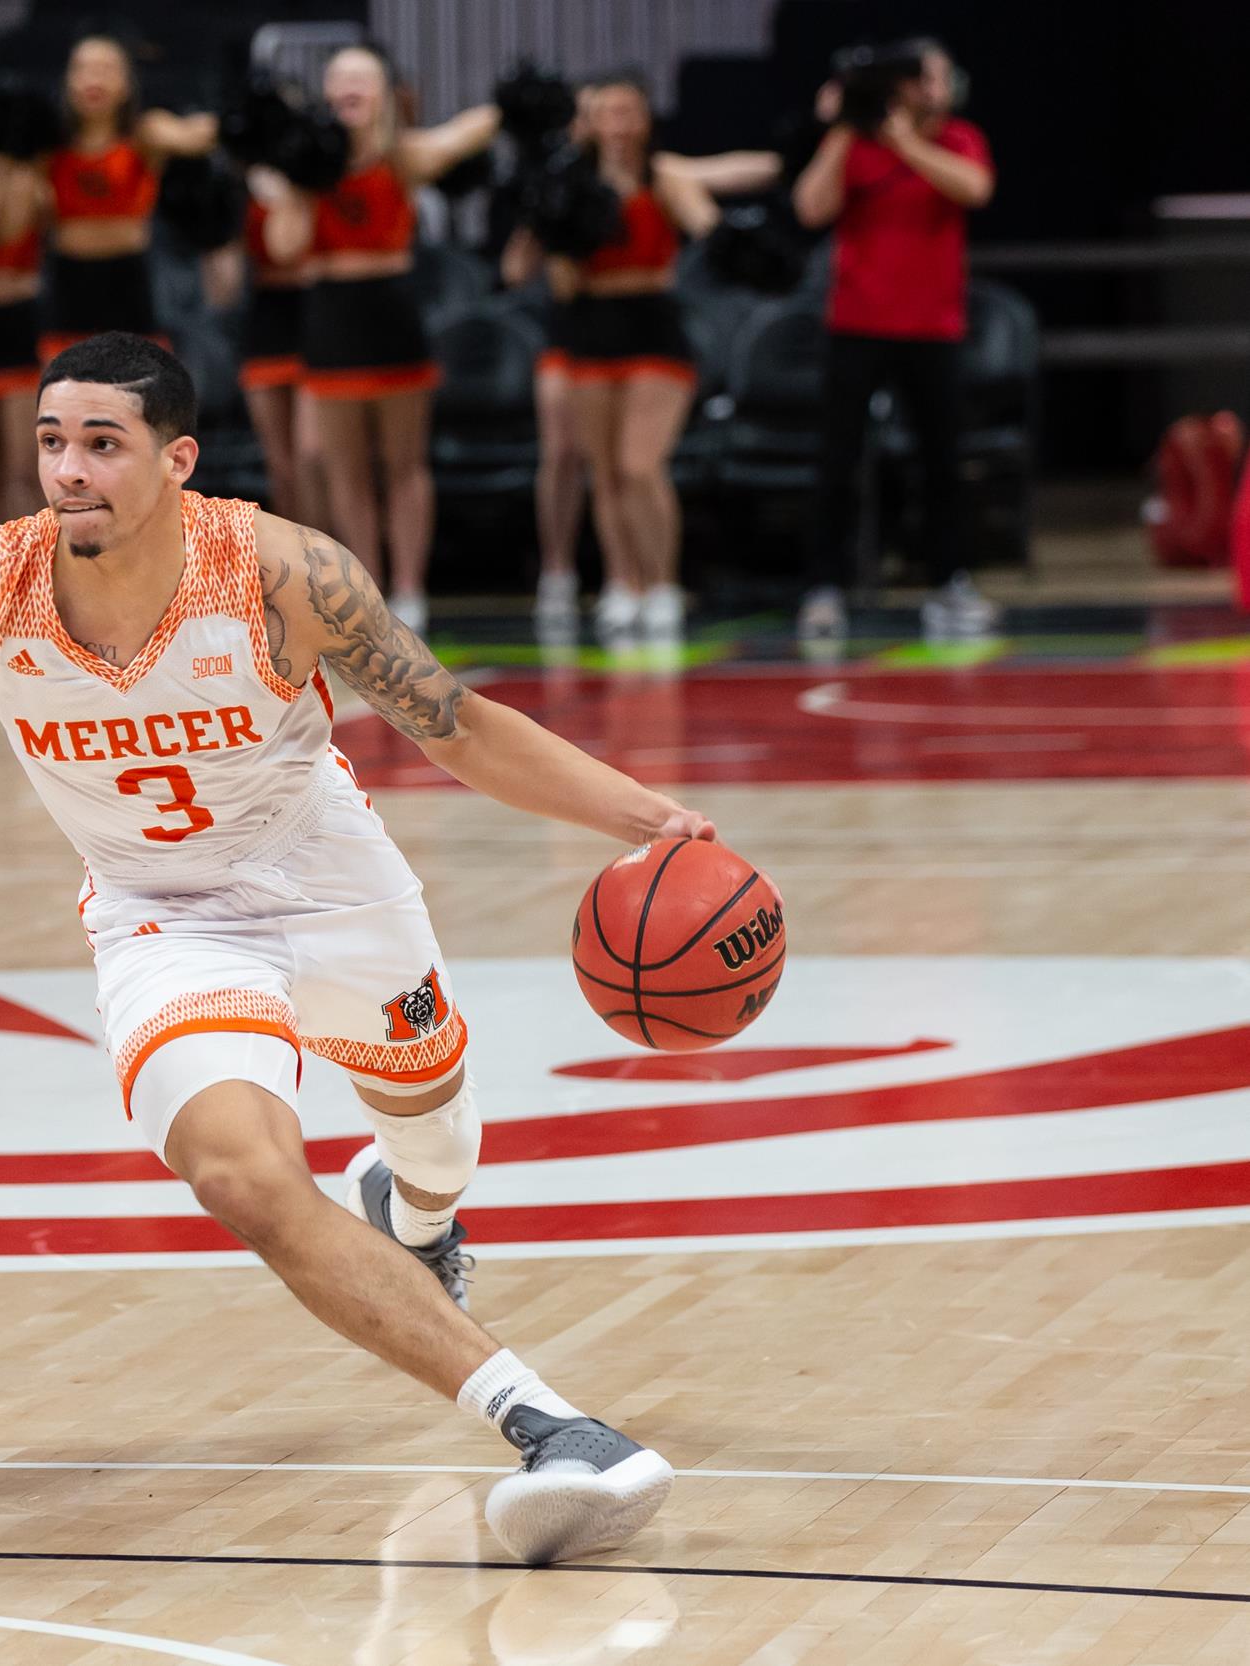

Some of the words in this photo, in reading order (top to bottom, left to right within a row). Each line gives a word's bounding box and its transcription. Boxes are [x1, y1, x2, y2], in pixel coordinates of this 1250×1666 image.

[7, 658, 45, 677] adidas
[192, 652, 233, 680] SOCON
[14, 704, 264, 763] MERCER
[113, 763, 215, 843] 3
[713, 901, 784, 970] Wilso
